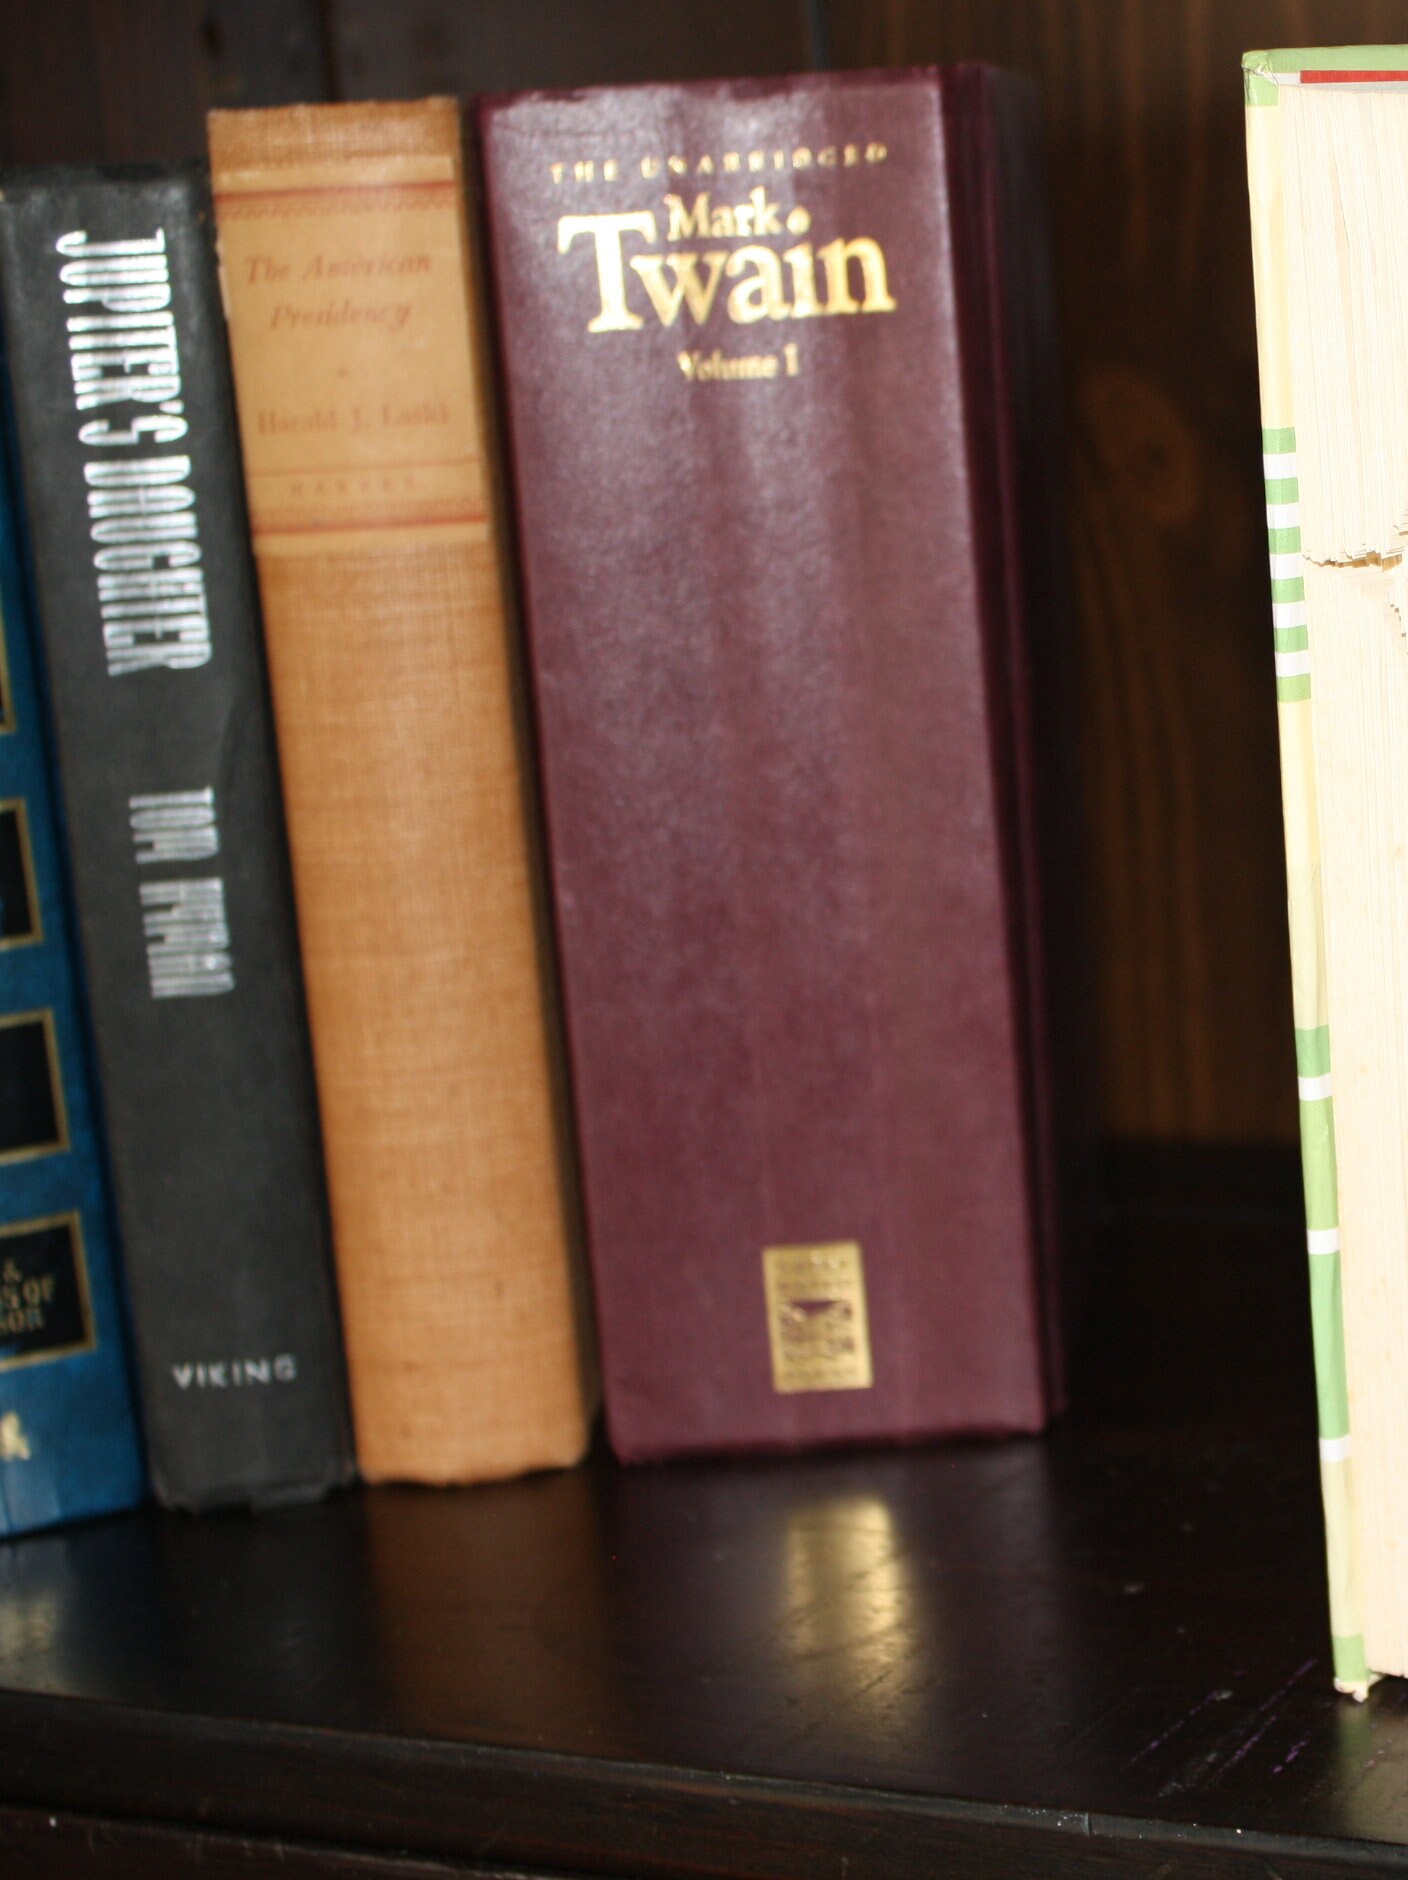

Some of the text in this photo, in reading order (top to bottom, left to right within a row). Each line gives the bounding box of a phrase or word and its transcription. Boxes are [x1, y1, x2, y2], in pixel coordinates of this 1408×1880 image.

[551, 142, 888, 185] THE UNABRIDGED
[664, 185, 782, 241] Mark
[245, 250, 433, 285] The American
[557, 210, 897, 333] Twain
[269, 299, 412, 335] Presidency
[677, 347, 779, 382] Volume
[55, 228, 213, 677] JUPITER'S DAUGHTER
[172, 1352, 298, 1390] VIKING
